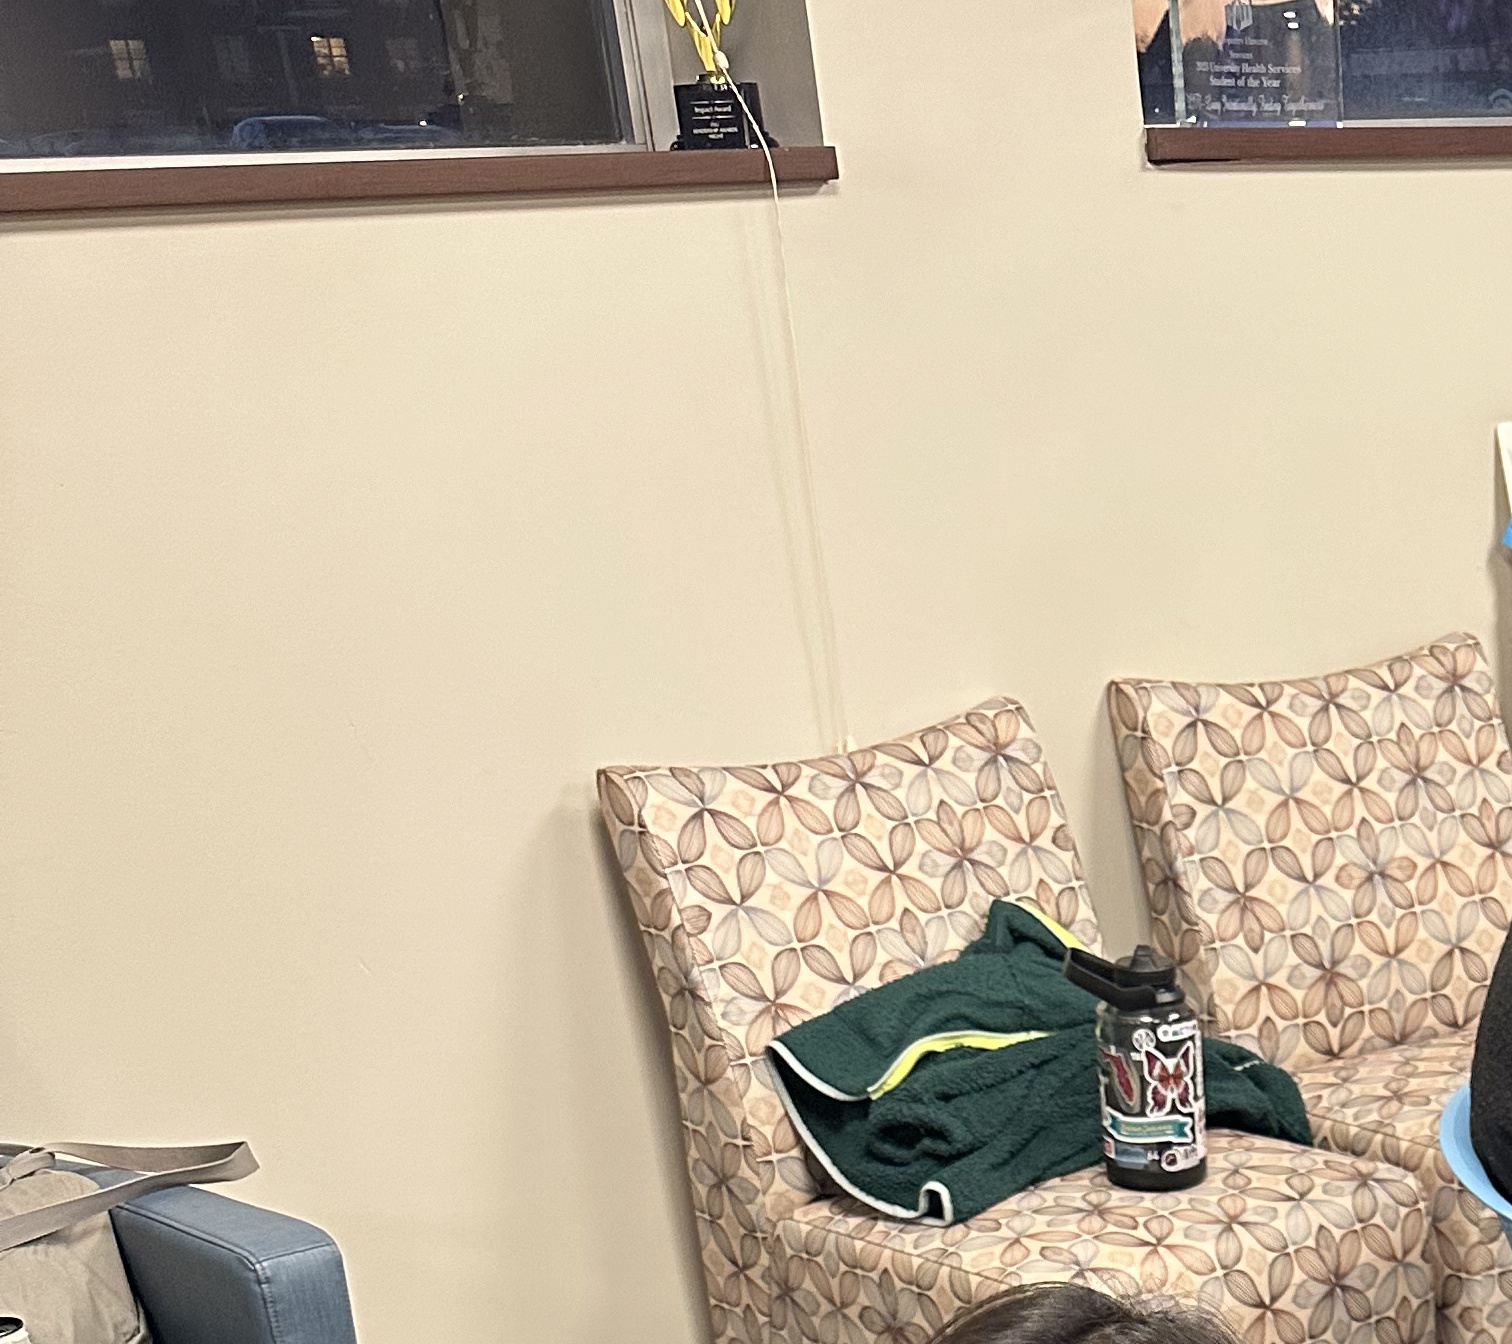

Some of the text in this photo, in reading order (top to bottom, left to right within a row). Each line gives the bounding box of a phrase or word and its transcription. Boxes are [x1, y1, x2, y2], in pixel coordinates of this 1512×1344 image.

[1242, 62, 1266, 73] Health
[1268, 63, 1302, 74] Services
[1209, 76, 1281, 88] Student of the Year
